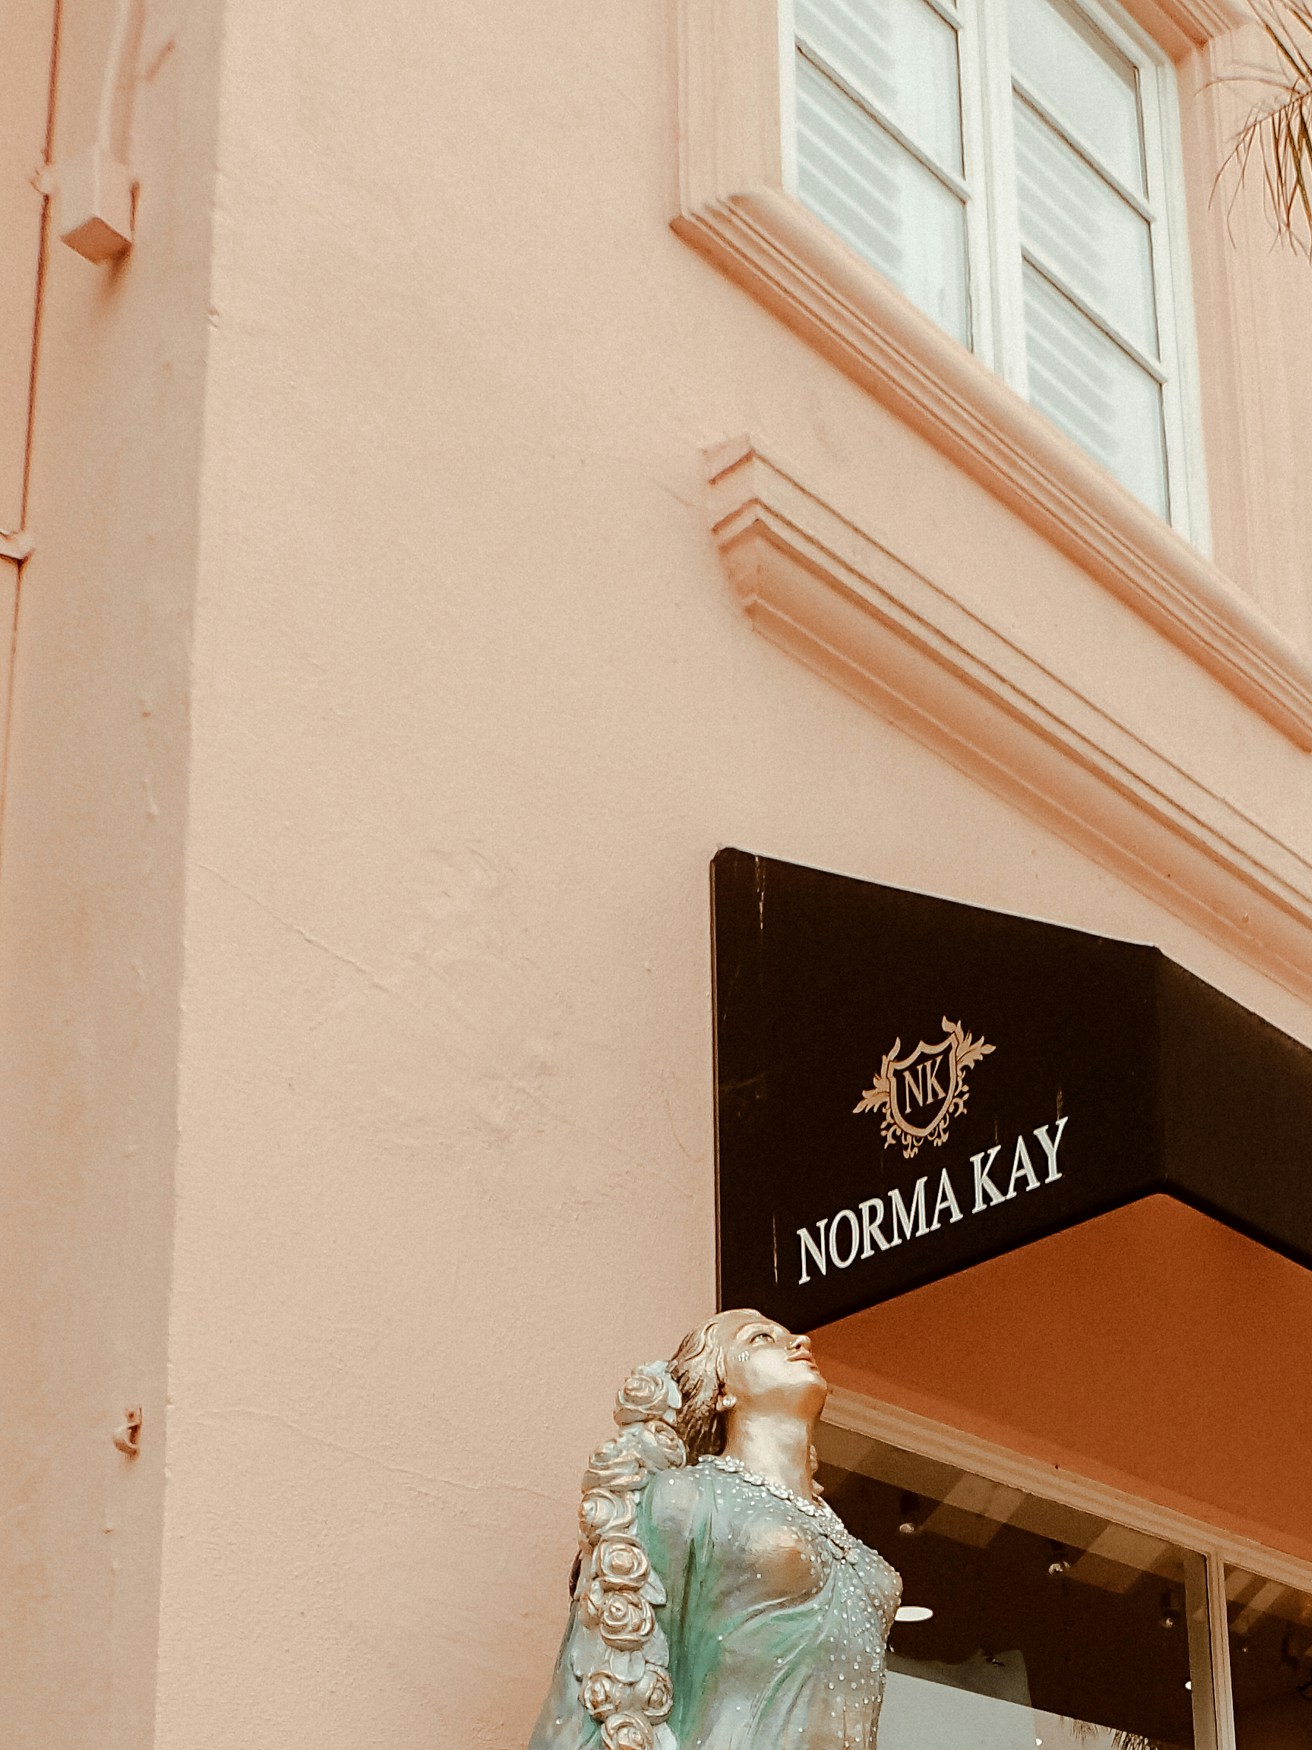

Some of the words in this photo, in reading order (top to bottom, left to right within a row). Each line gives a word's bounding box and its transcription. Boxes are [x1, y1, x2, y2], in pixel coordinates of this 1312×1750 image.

[903, 1055, 946, 1114] NK
[796, 1167, 964, 1285] NORMA
[969, 1116, 1069, 1214] KAY
